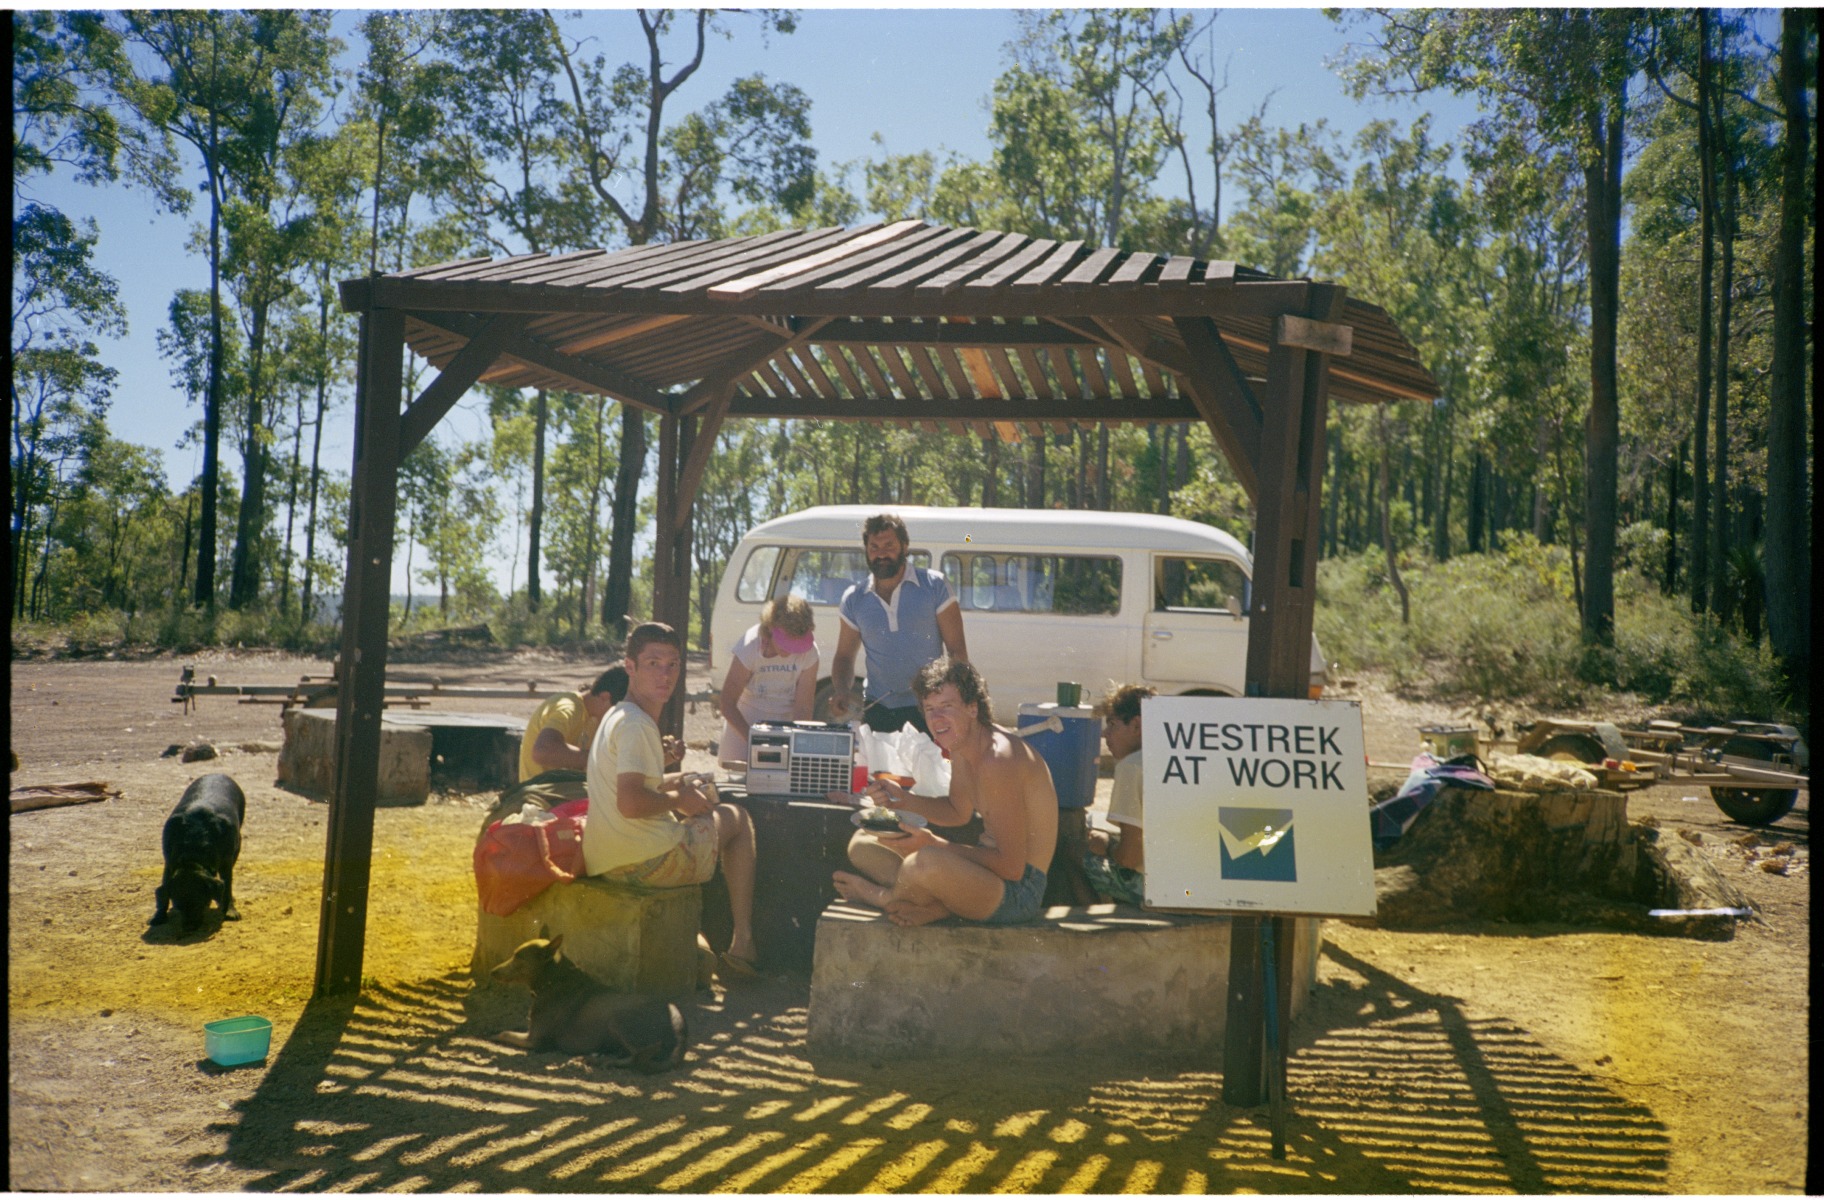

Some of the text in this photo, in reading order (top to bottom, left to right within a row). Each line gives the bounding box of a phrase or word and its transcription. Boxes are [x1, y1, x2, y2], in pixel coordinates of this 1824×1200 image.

[1163, 722, 1343, 756] WESTREK
[1162, 756, 1345, 791] AT WORK
